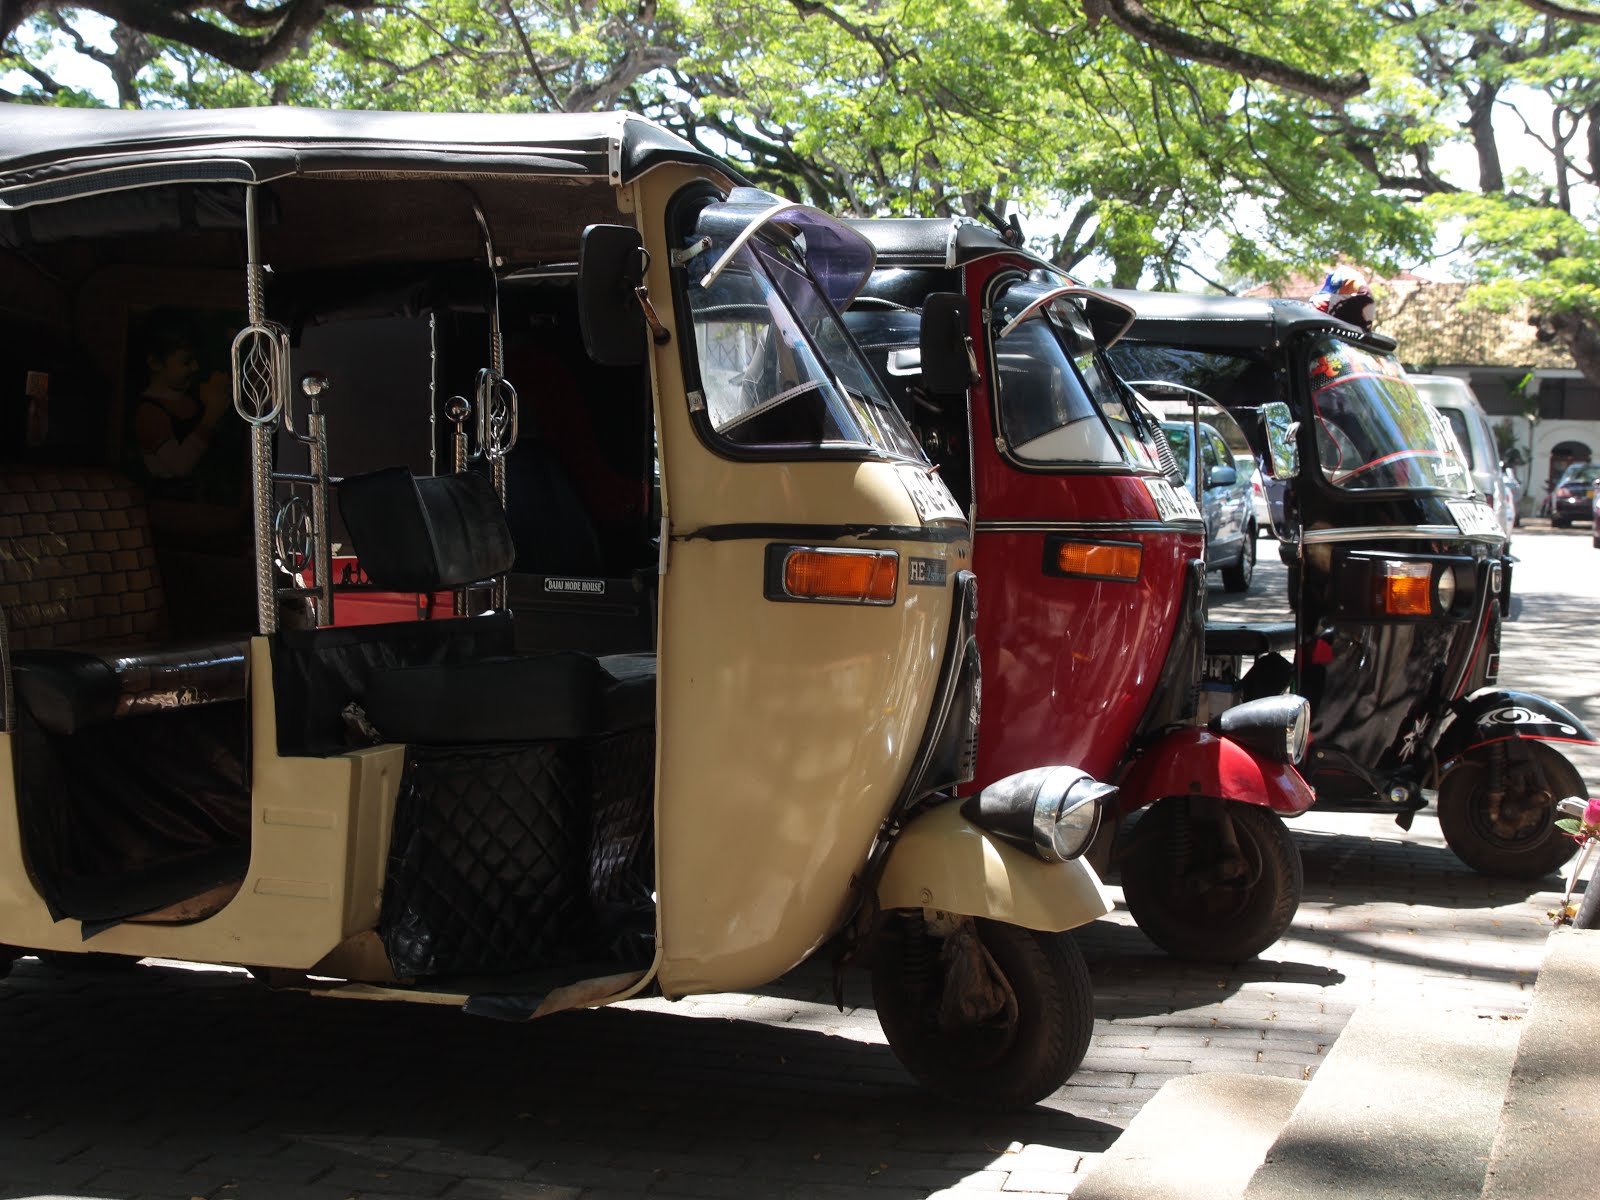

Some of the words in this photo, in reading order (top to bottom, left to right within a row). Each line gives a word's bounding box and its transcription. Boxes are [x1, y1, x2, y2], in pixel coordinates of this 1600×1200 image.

[910, 561, 926, 581] RE
[548, 580, 564, 590] BAJAJ
[564, 580, 581, 591] MODE
[581, 581, 602, 592] HOUSE
